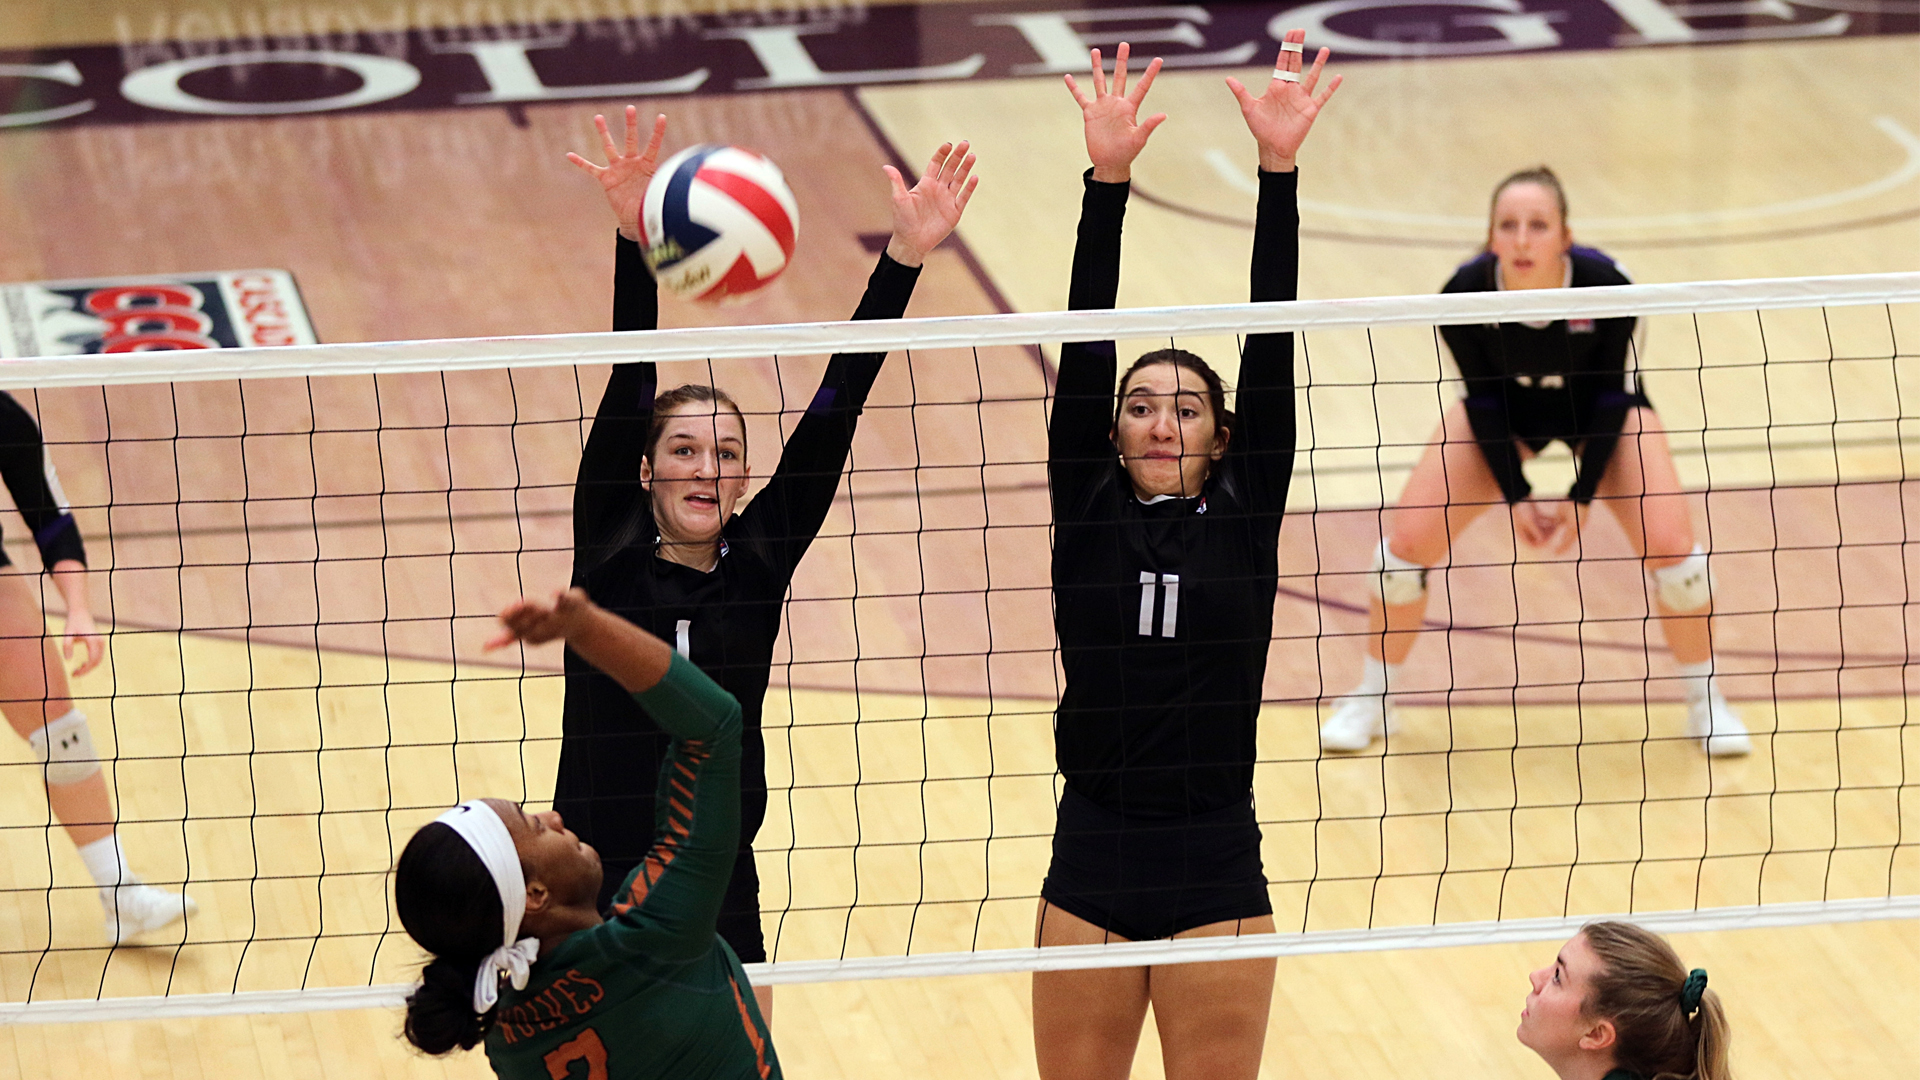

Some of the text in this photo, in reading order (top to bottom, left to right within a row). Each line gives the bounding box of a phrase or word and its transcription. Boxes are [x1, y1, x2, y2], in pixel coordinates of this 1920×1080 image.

[1139, 571, 1179, 638] 11
[675, 619, 691, 661] 1
[496, 968, 605, 1044] WOLVES
